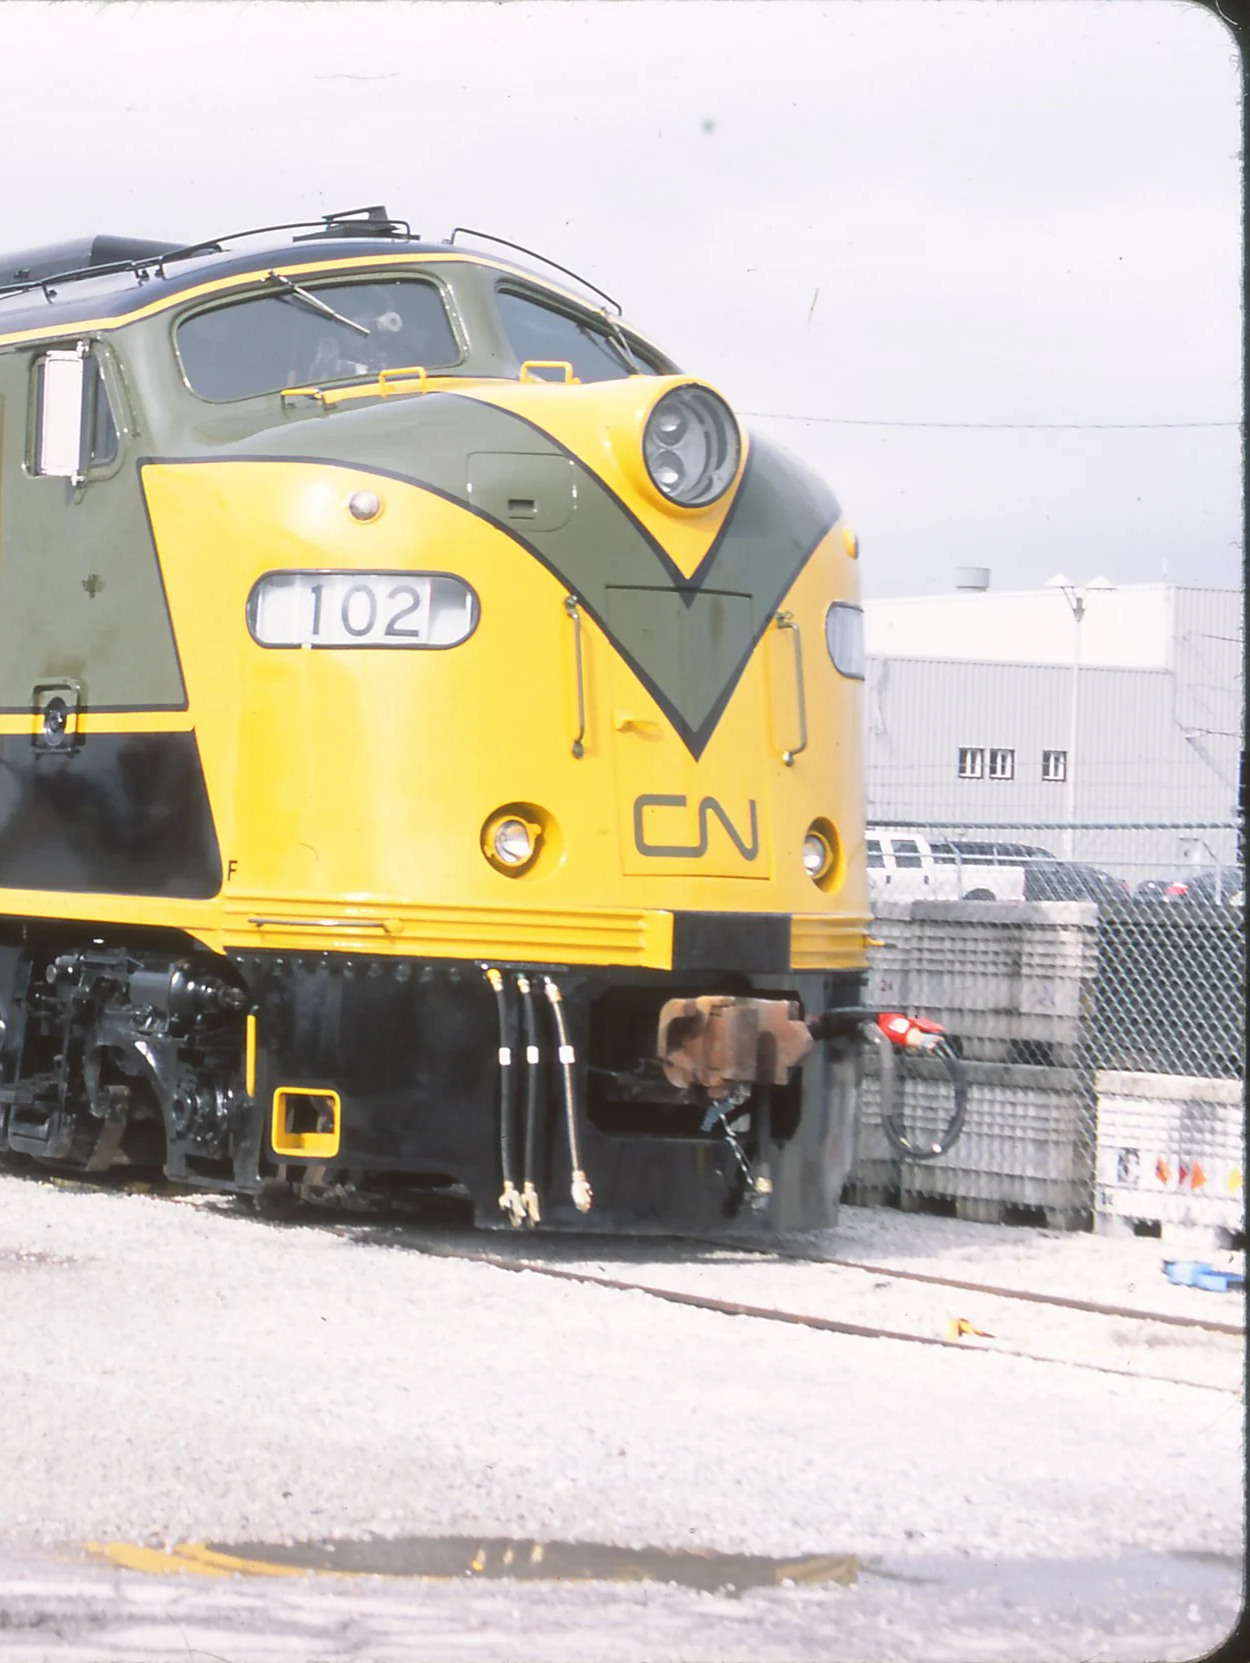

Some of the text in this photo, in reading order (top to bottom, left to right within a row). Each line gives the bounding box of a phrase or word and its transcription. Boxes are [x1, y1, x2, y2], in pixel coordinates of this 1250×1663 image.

[309, 585, 421, 637] 102
[634, 794, 757, 861] CN
[227, 859, 238, 881] F
